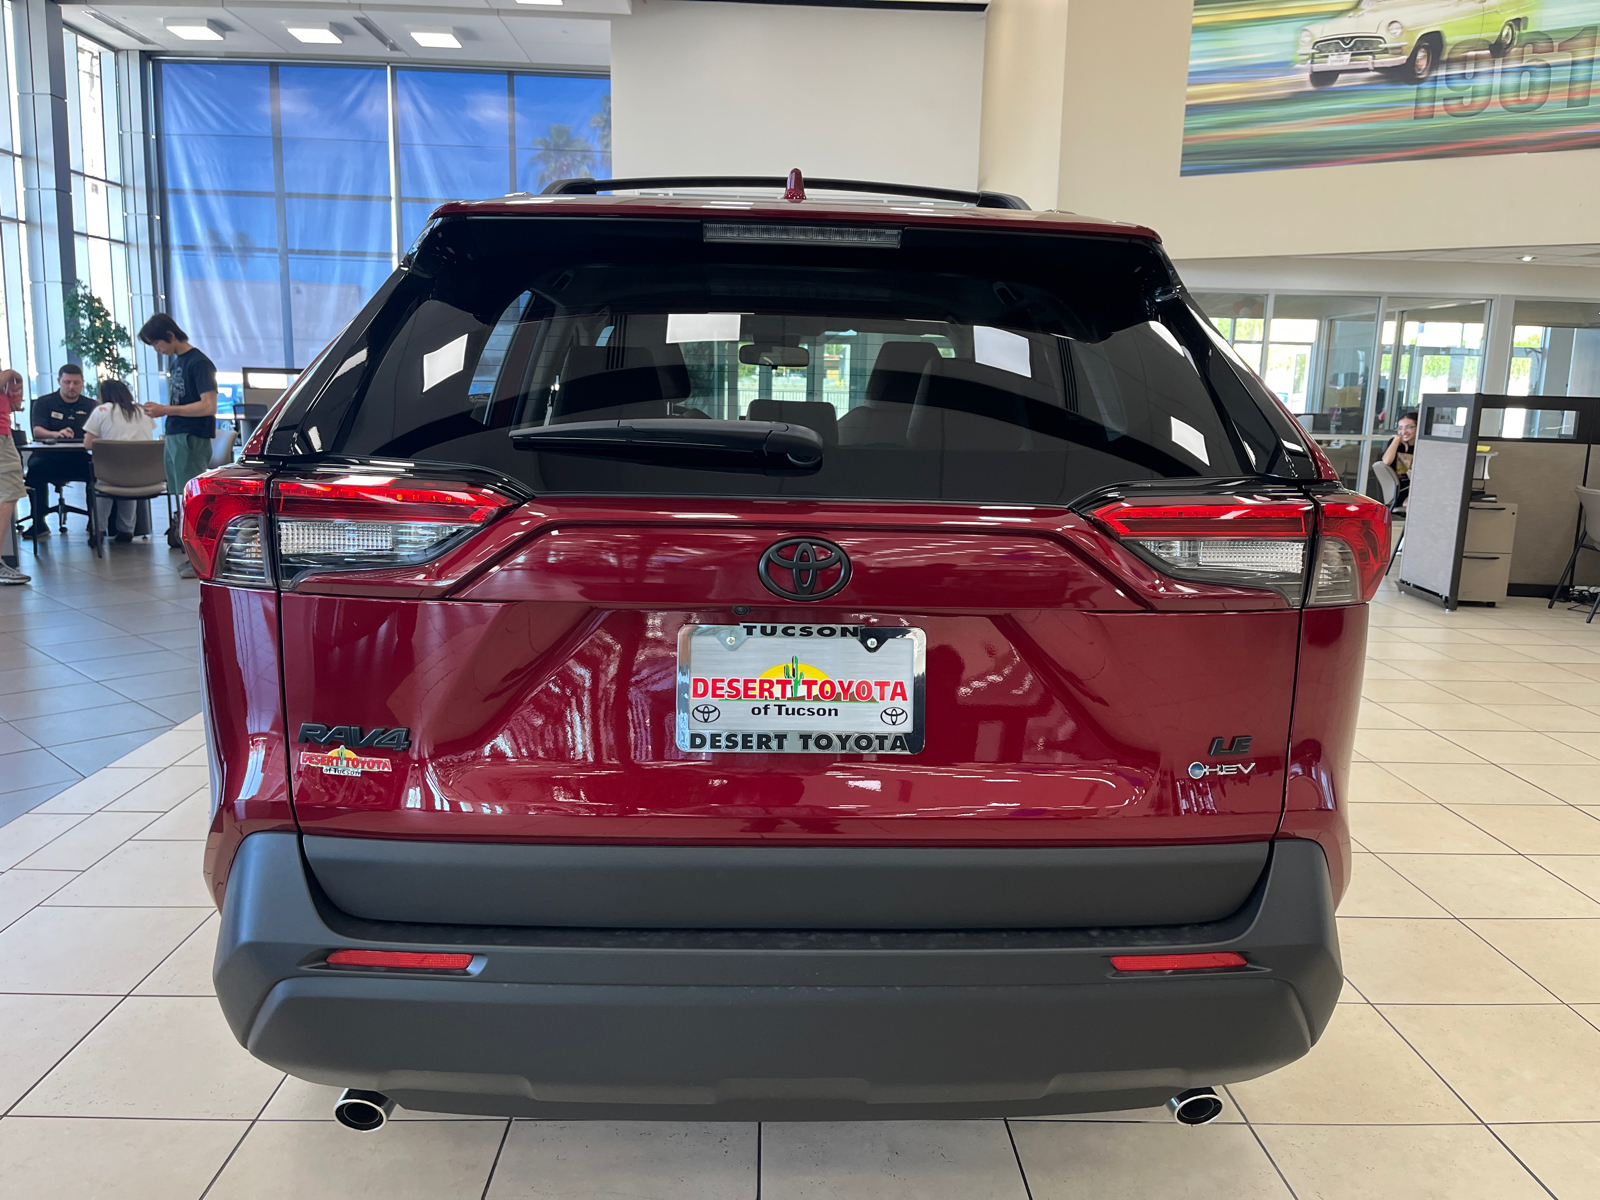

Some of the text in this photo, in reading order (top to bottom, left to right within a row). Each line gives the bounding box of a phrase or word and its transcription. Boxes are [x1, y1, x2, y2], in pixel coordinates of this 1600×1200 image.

[1413, 26, 1599, 120] 1961
[744, 625, 860, 638] TUCSON
[692, 678, 908, 702] DESERT TOYOTA
[751, 704, 839, 717] of Tucson
[297, 723, 411, 751] RAV4
[690, 733, 907, 751] DESERT TOYOTA
[1208, 736, 1253, 755] LE
[302, 753, 391, 771] DESERT TOYOTA
